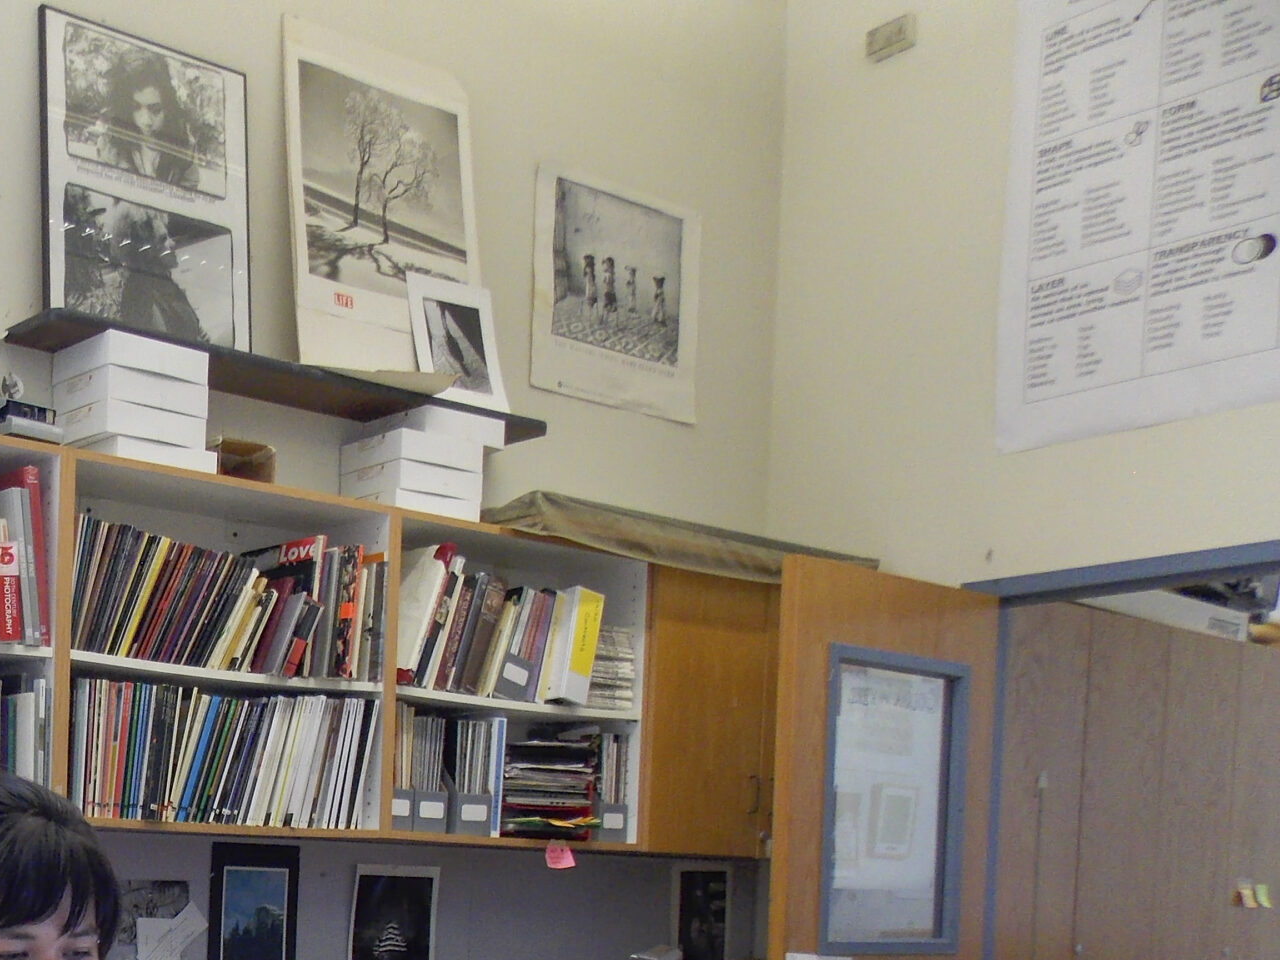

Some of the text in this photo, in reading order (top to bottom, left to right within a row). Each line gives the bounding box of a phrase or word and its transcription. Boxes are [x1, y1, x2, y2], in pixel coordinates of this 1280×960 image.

[1031, 277, 1065, 294] LAYER
[334, 293, 353, 309] LIFE
[4, 576, 13, 635] PHOTOGRAPHY
